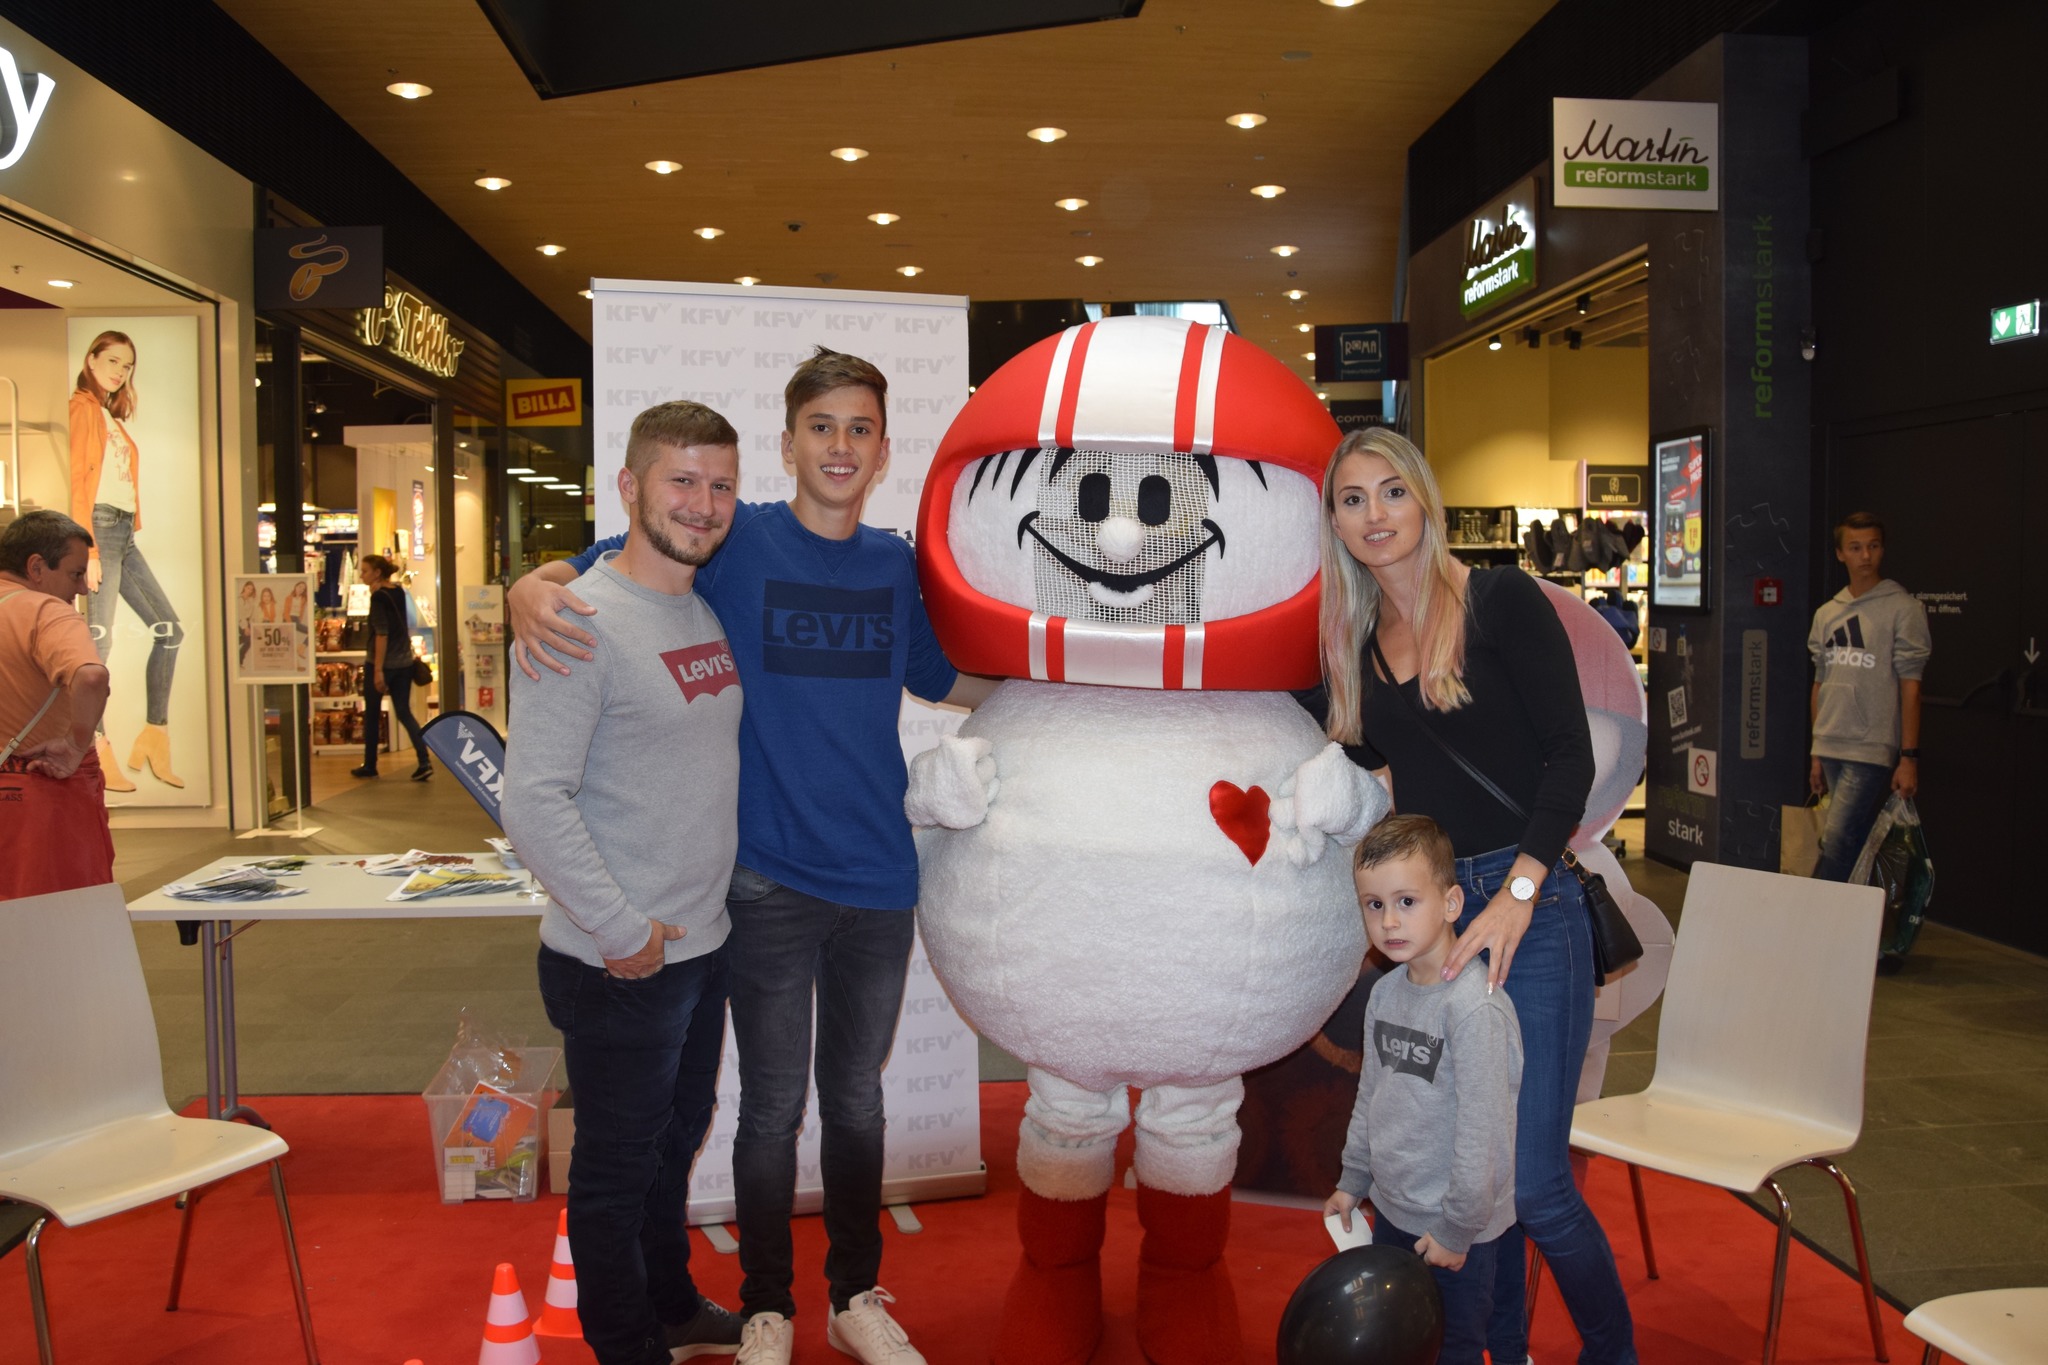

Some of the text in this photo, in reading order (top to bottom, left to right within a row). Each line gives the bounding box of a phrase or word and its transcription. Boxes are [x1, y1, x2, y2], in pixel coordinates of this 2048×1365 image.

[1564, 119, 1709, 164] Martin
[1576, 168, 1697, 187] reformstark
[1462, 204, 1528, 272] Martin
[1464, 260, 1519, 305] reformstark
[606, 304, 943, 335] KFV KFV KFV KFV KFV
[1751, 214, 1773, 419] reformstark
[606, 347, 659, 365] KFV
[681, 349, 732, 368] KFV
[896, 357, 943, 375] KFV
[516, 390, 572, 415] BILLA
[754, 393, 785, 410] KF
[896, 398, 944, 415] KFV
[1825, 646, 1876, 669] adidas
[1746, 641, 1763, 749] reformstark
[901, 719, 948, 737] KFV
[1668, 818, 1704, 847] stark
[906, 1034, 951, 1054] KFV
[906, 1072, 955, 1093] KFV
[907, 1111, 955, 1132] KFV
[908, 1150, 957, 1170] KFV
[698, 1172, 731, 1191] KF
